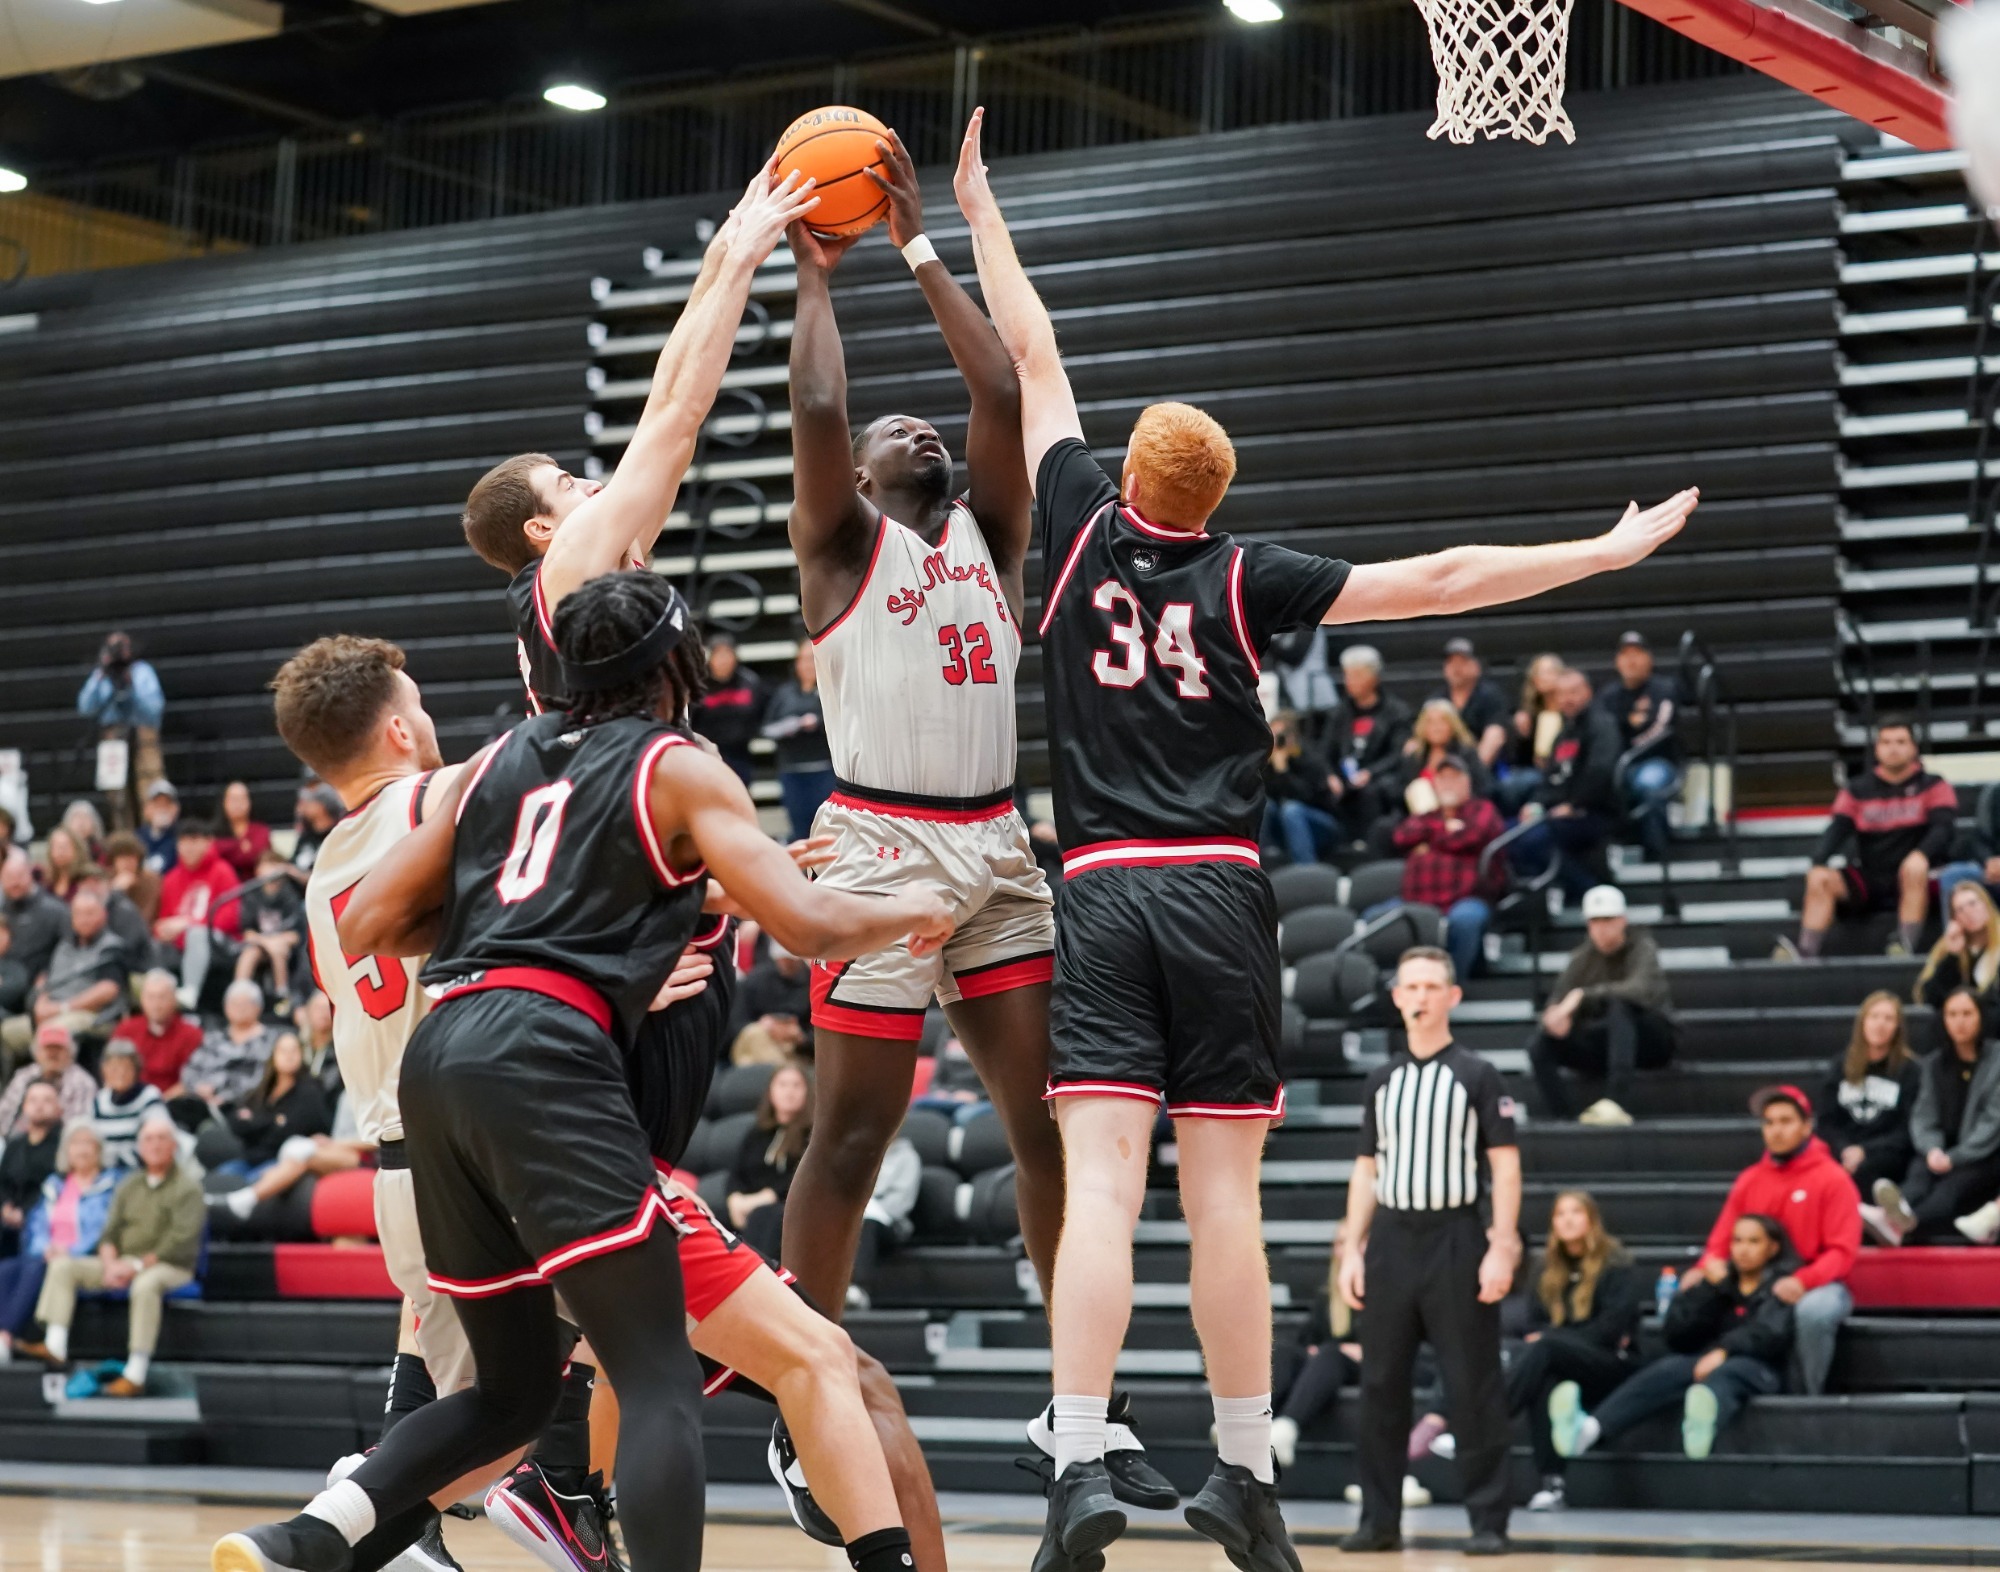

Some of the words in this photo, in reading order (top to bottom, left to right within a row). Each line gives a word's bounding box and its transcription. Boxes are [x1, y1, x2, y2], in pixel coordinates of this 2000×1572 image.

[780, 109, 862, 146] Wilson
[938, 622, 998, 686] 32
[1091, 578, 1212, 699] 34
[495, 777, 573, 906] 0
